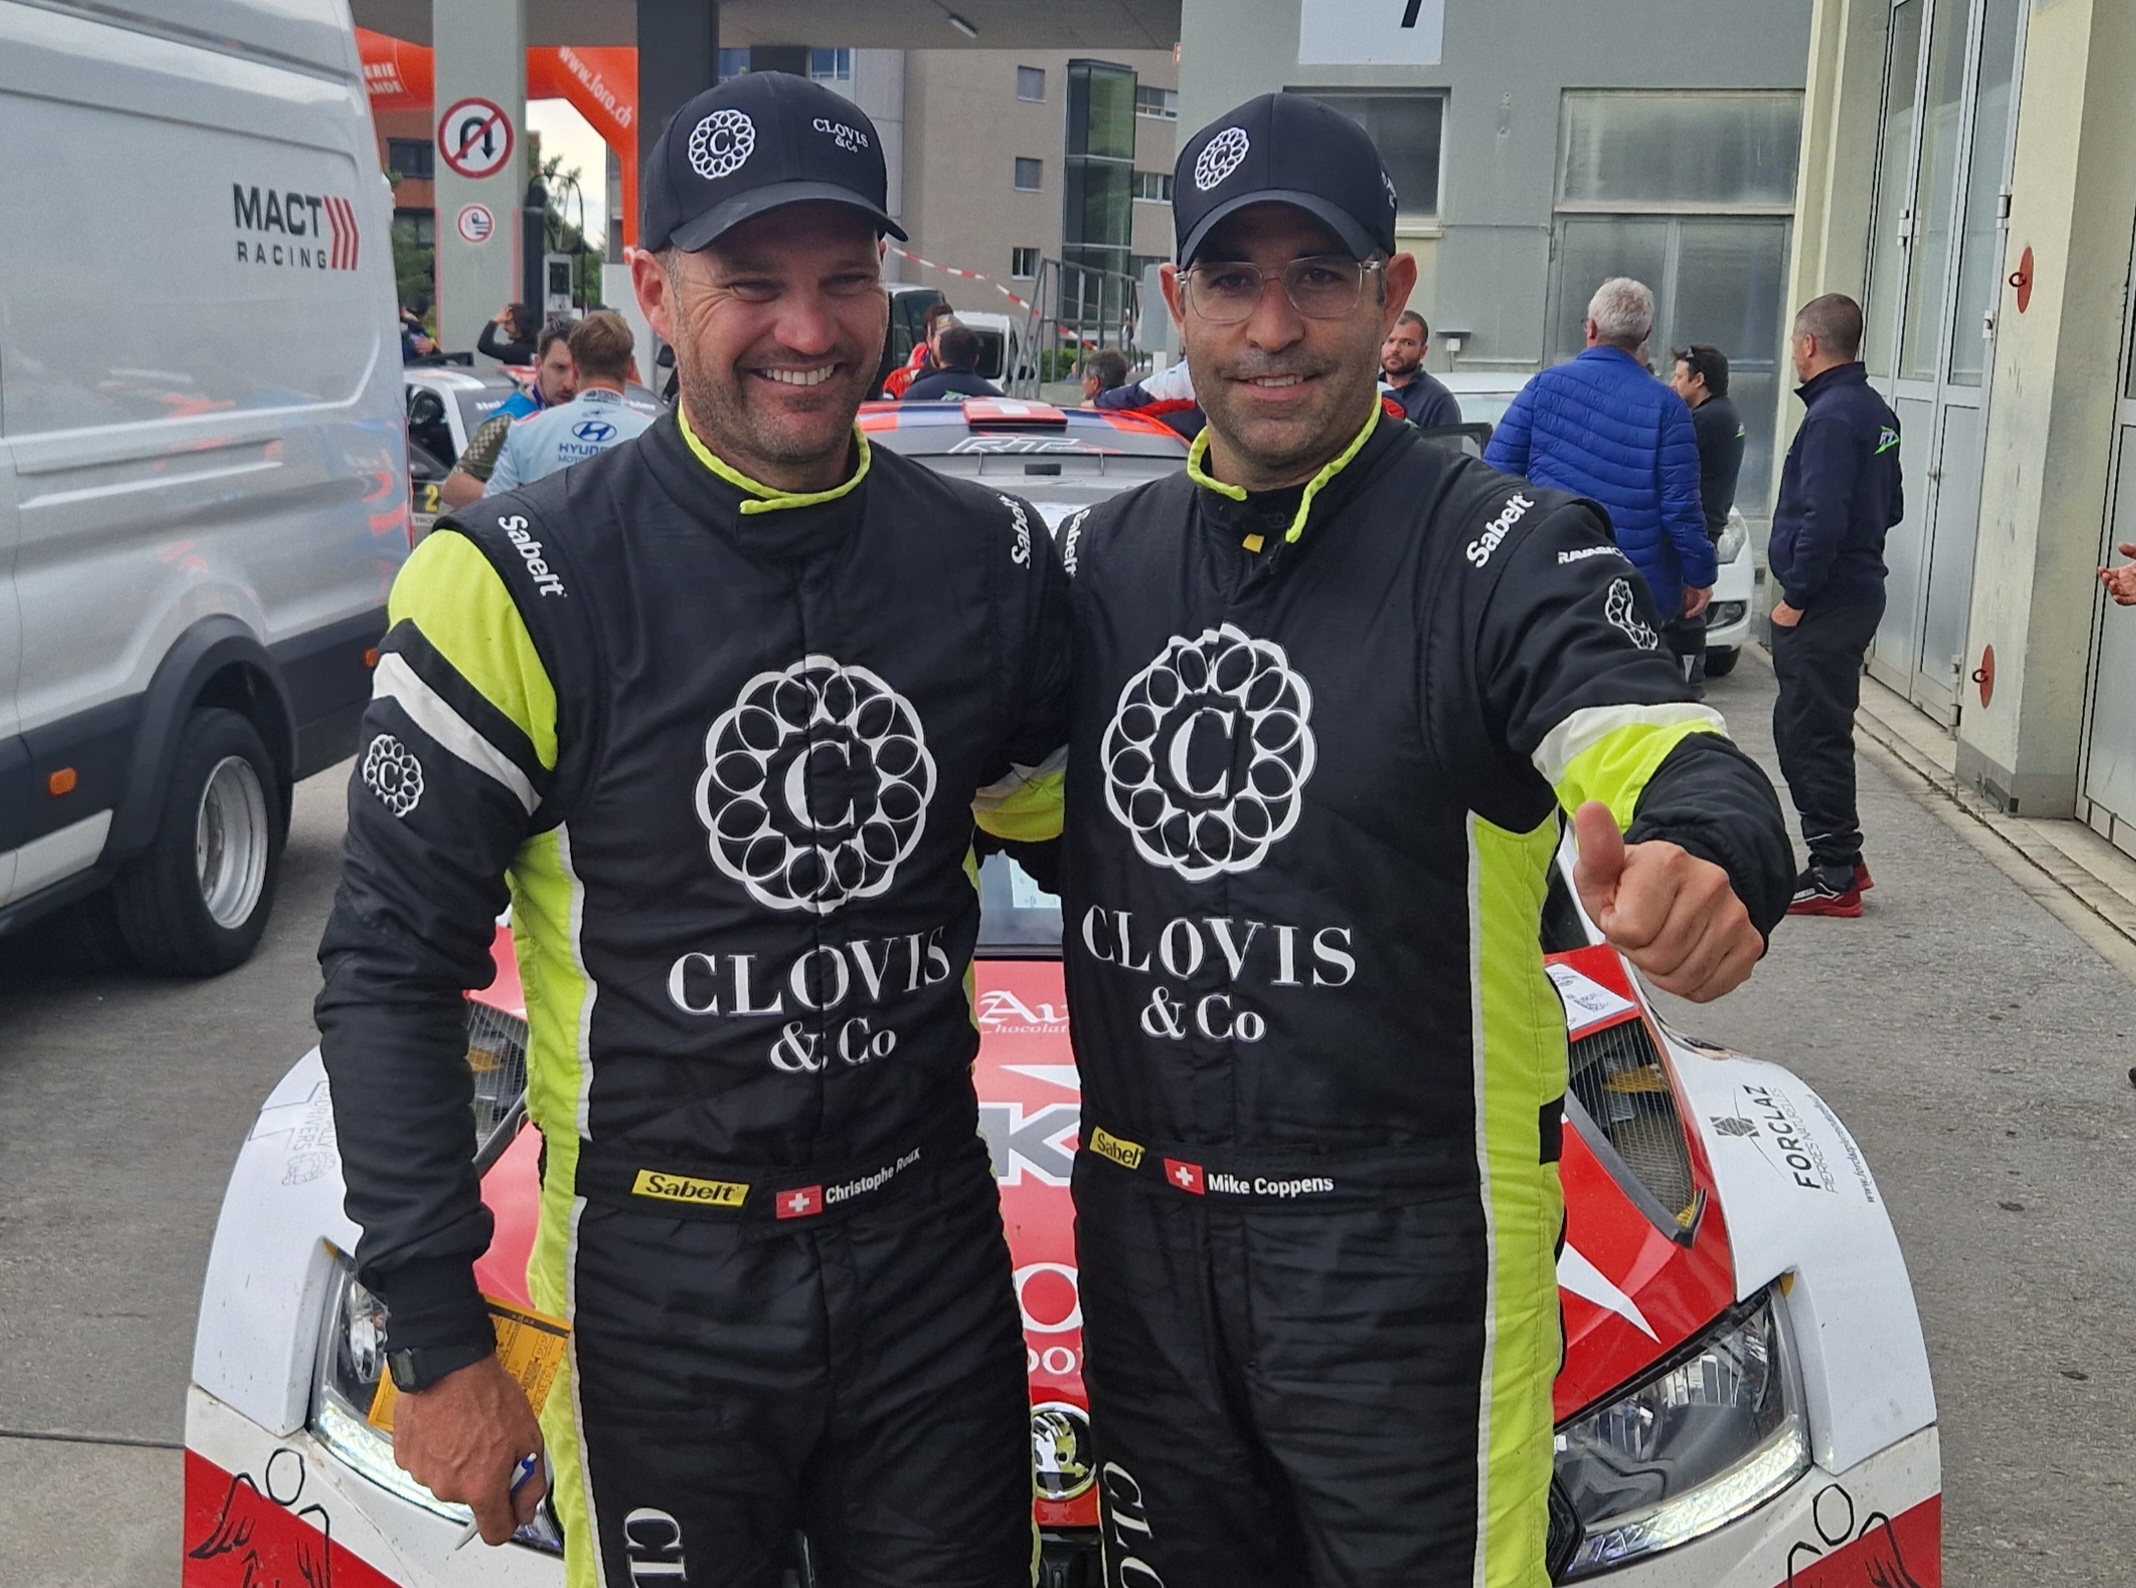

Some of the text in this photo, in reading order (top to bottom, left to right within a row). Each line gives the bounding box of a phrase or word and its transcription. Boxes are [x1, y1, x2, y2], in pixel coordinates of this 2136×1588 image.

[559, 45, 633, 129] www.loro.ch
[813, 118, 869, 148] CLOVIS
[233, 183, 323, 238] MACT
[237, 241, 327, 269] RACING
[498, 515, 565, 597] Sabelt
[1466, 492, 1535, 568] Sabelt
[1170, 707, 1236, 799] C
[784, 740, 855, 831] C
[666, 925, 951, 1017] CLOVIS
[1081, 904, 1357, 987] CLOVIS
[981, 1023, 1068, 1034] hocolat
[1140, 985, 1267, 1042] & Co
[768, 1015, 898, 1073] & Co
[1742, 1084, 1822, 1190] FORCLAZ
[645, 1174, 735, 1202] Sabelt
[825, 1166, 894, 1204] Christophe
[1208, 1173, 1334, 1198] Mike Coppens
[1804, 1141, 1839, 1194] PIERRES
